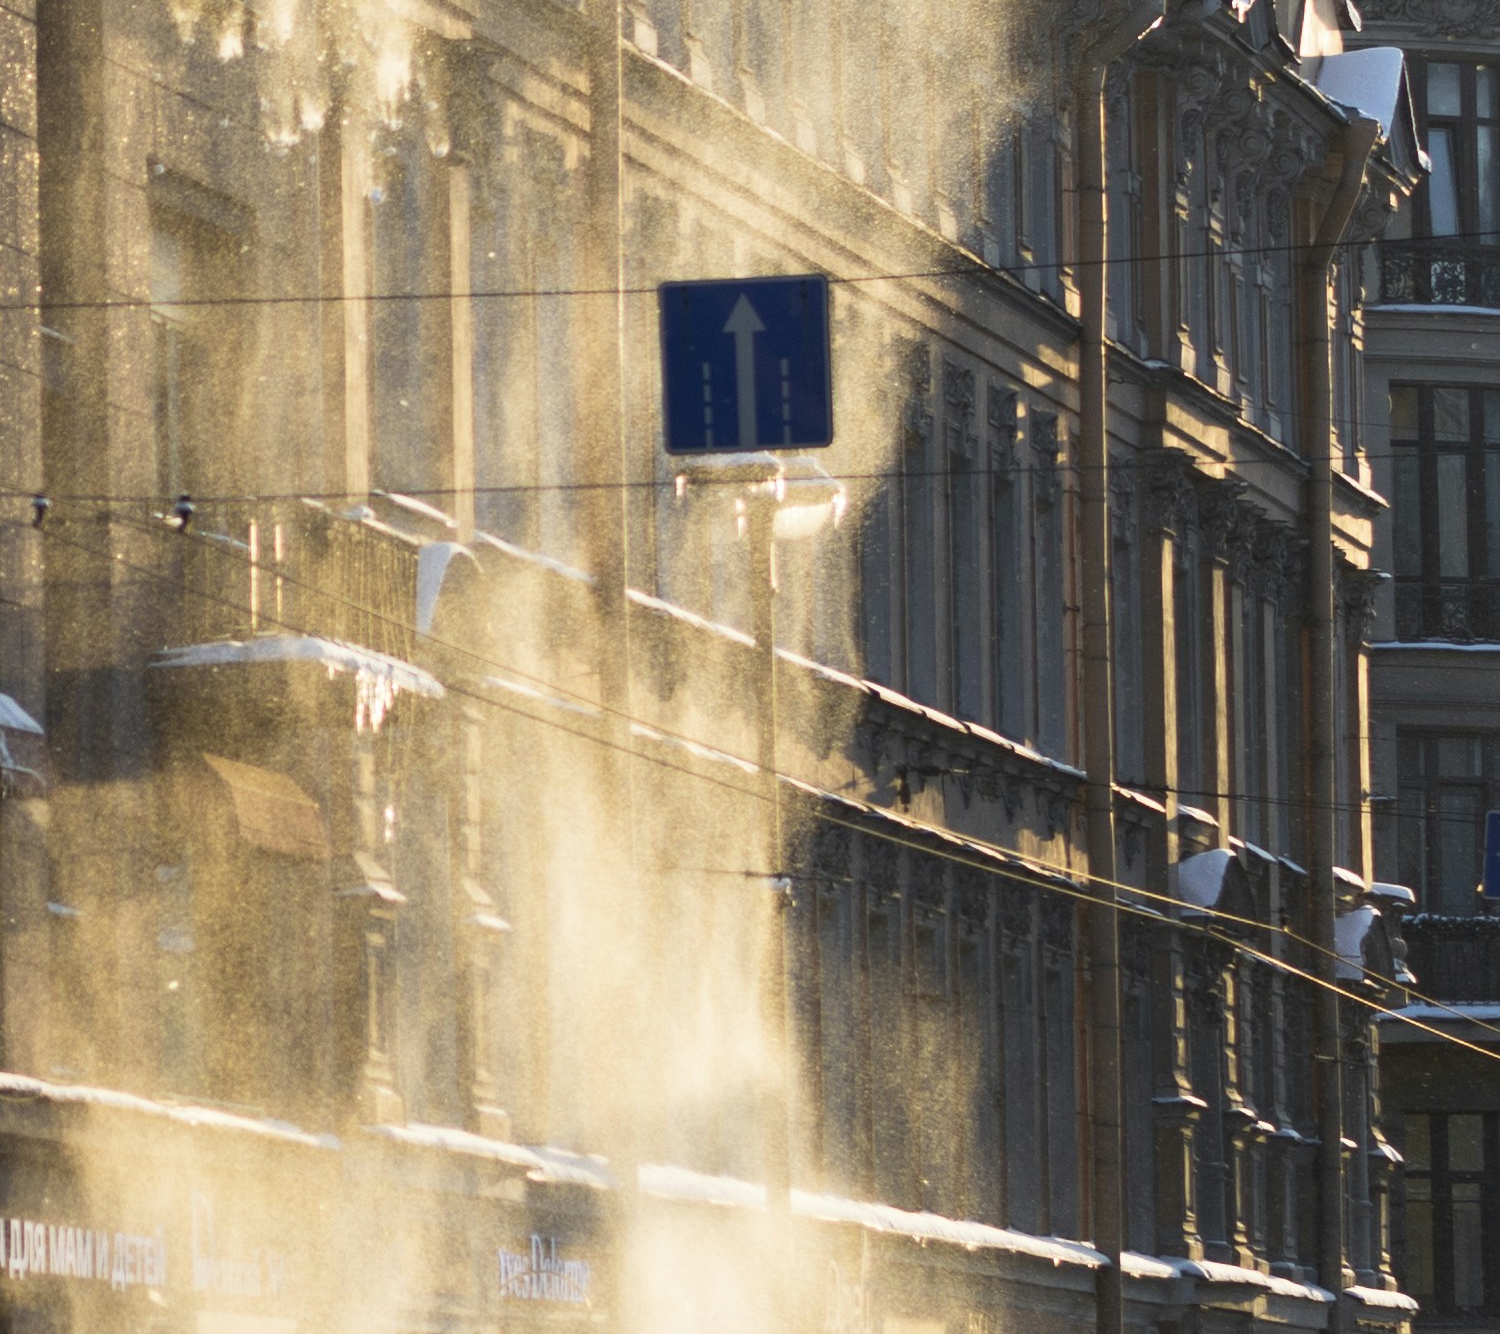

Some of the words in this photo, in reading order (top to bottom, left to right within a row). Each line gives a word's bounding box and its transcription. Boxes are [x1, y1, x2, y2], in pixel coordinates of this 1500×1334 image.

[9, 1218, 45, 1280] ДЛЯ
[49, 1225, 93, 1279] МАМ
[96, 1231, 109, 1279] И
